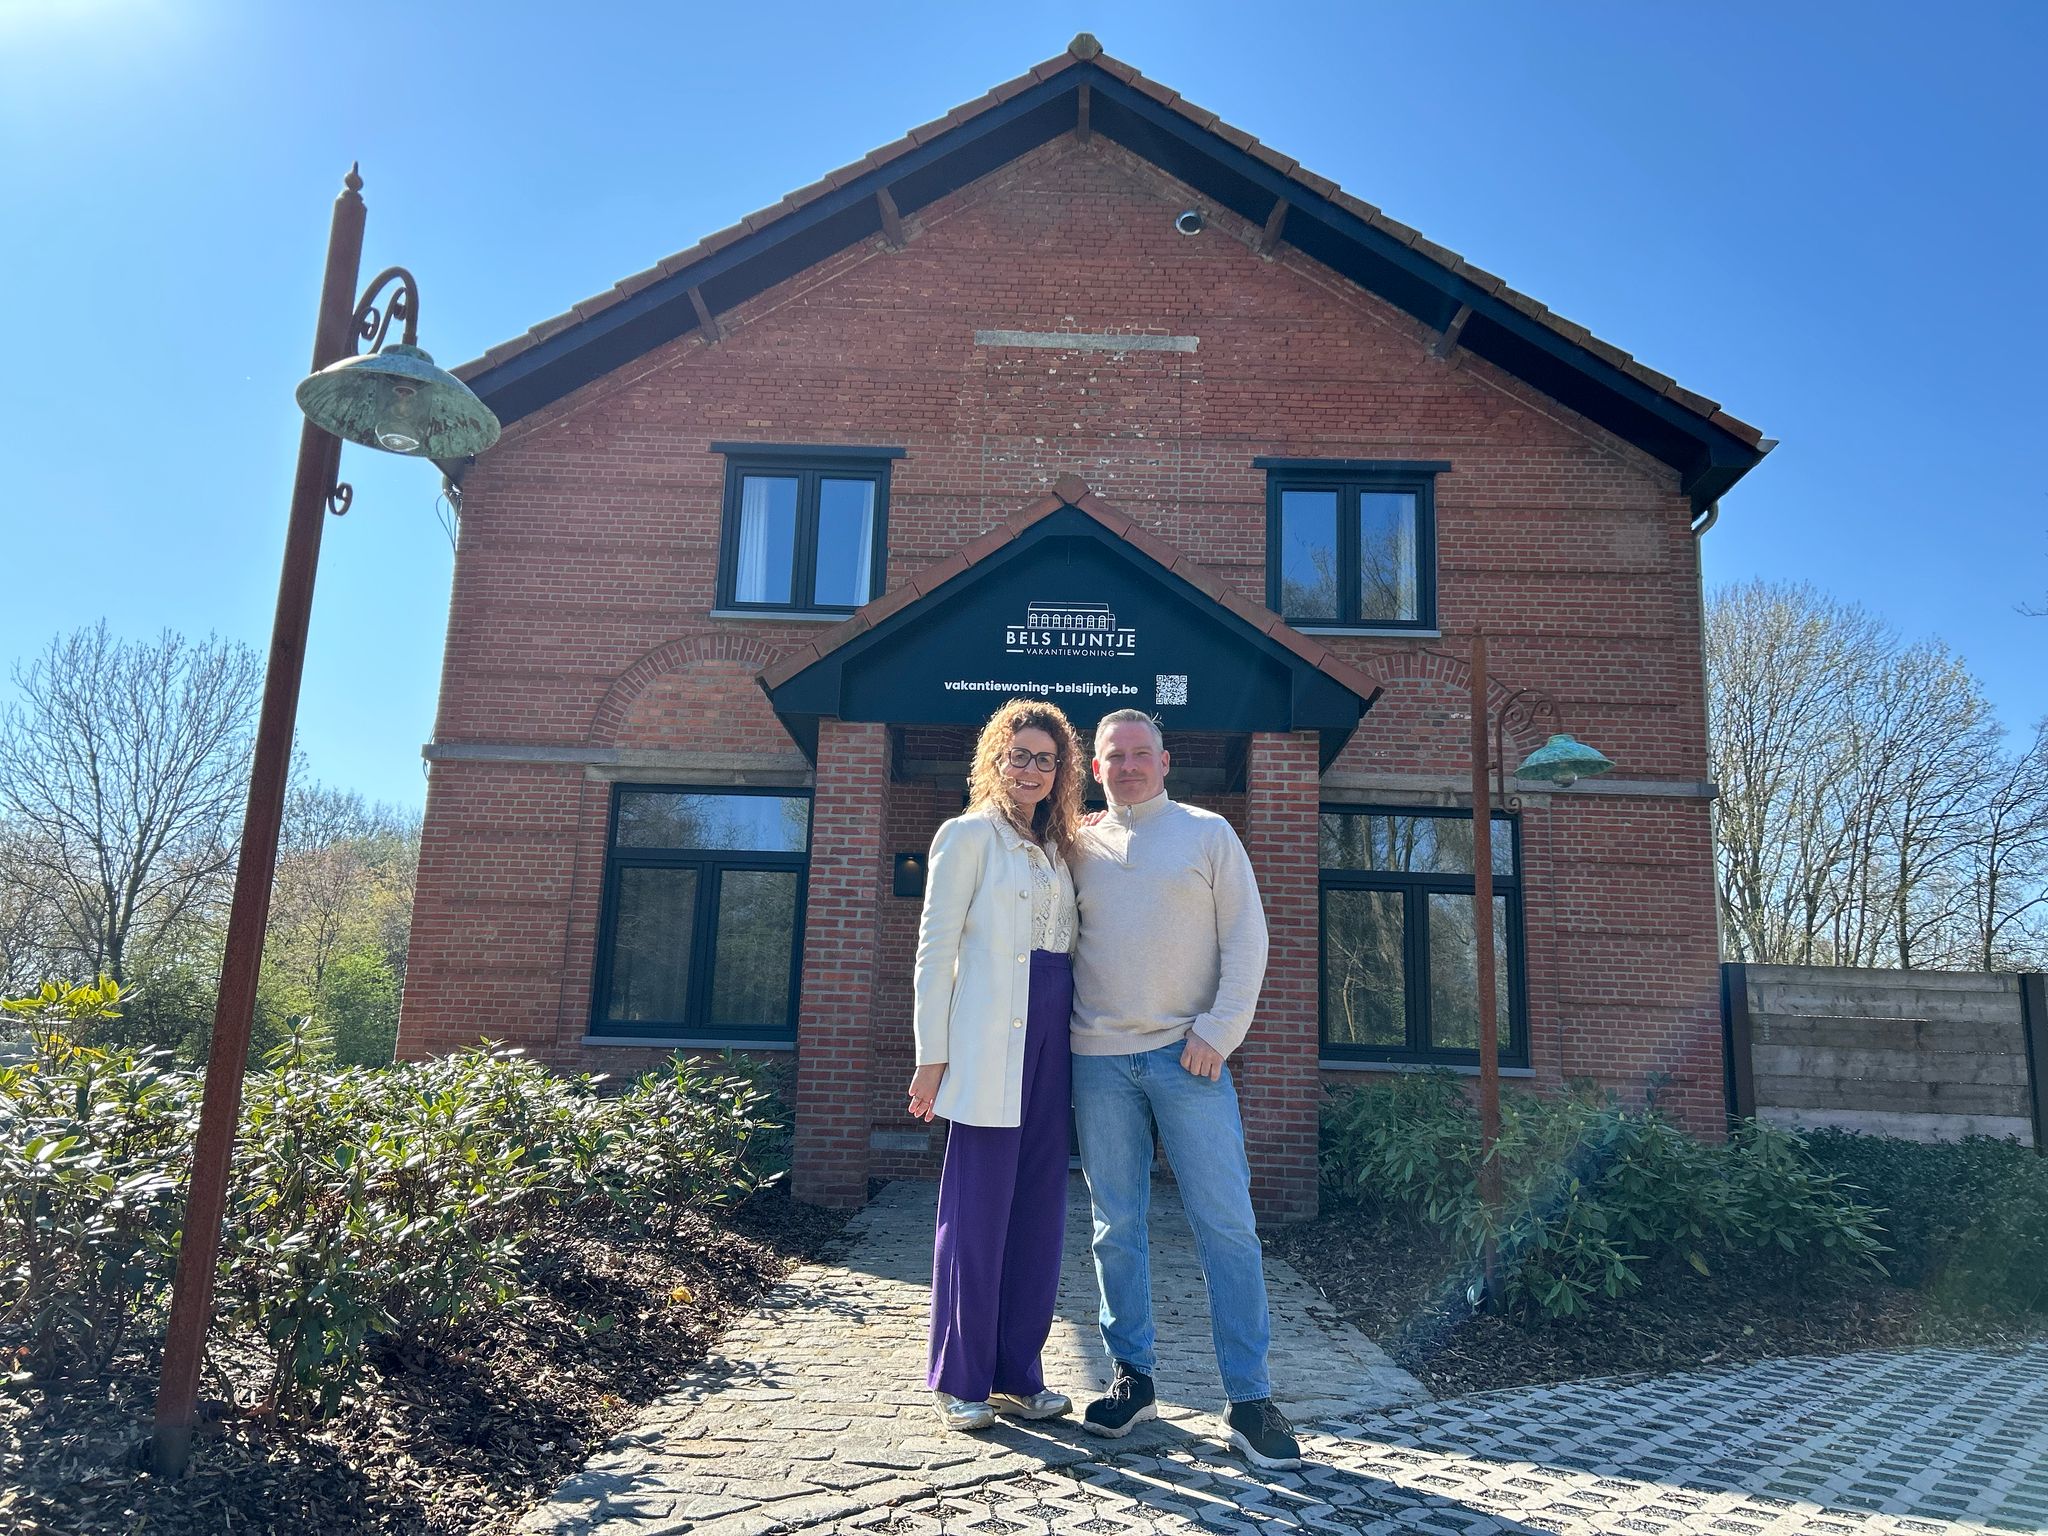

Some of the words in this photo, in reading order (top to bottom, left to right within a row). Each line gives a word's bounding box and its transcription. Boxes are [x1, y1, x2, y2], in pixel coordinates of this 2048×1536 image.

[1006, 631, 1051, 646] BELS
[1061, 632, 1136, 648] LIJNTJE
[1026, 648, 1115, 657] VAKANTIEWONING
[944, 680, 1138, 696] vakantiewoning-belslijntje.be
